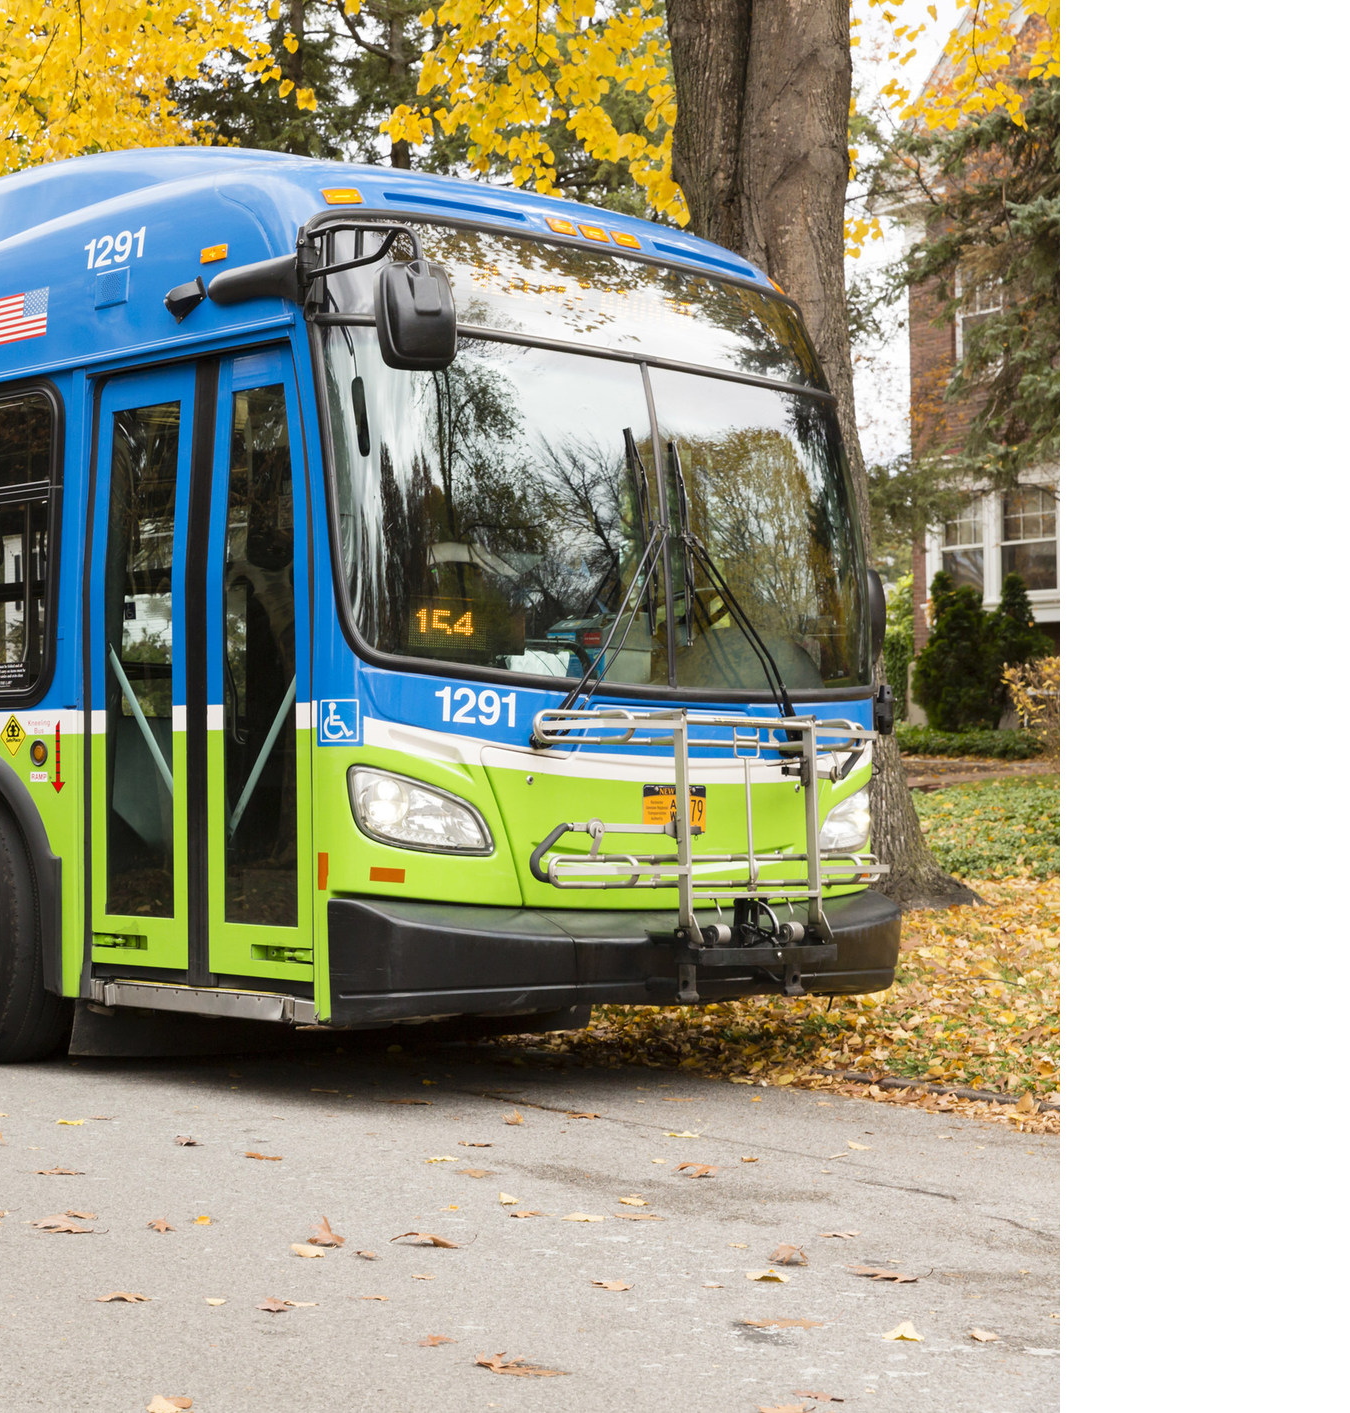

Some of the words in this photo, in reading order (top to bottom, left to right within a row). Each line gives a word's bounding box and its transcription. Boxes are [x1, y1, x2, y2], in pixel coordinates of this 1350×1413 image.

[83, 225, 147, 270] 1291
[415, 607, 474, 636] 154
[434, 685, 517, 728] 1291
[659, 787, 676, 795] NEW
